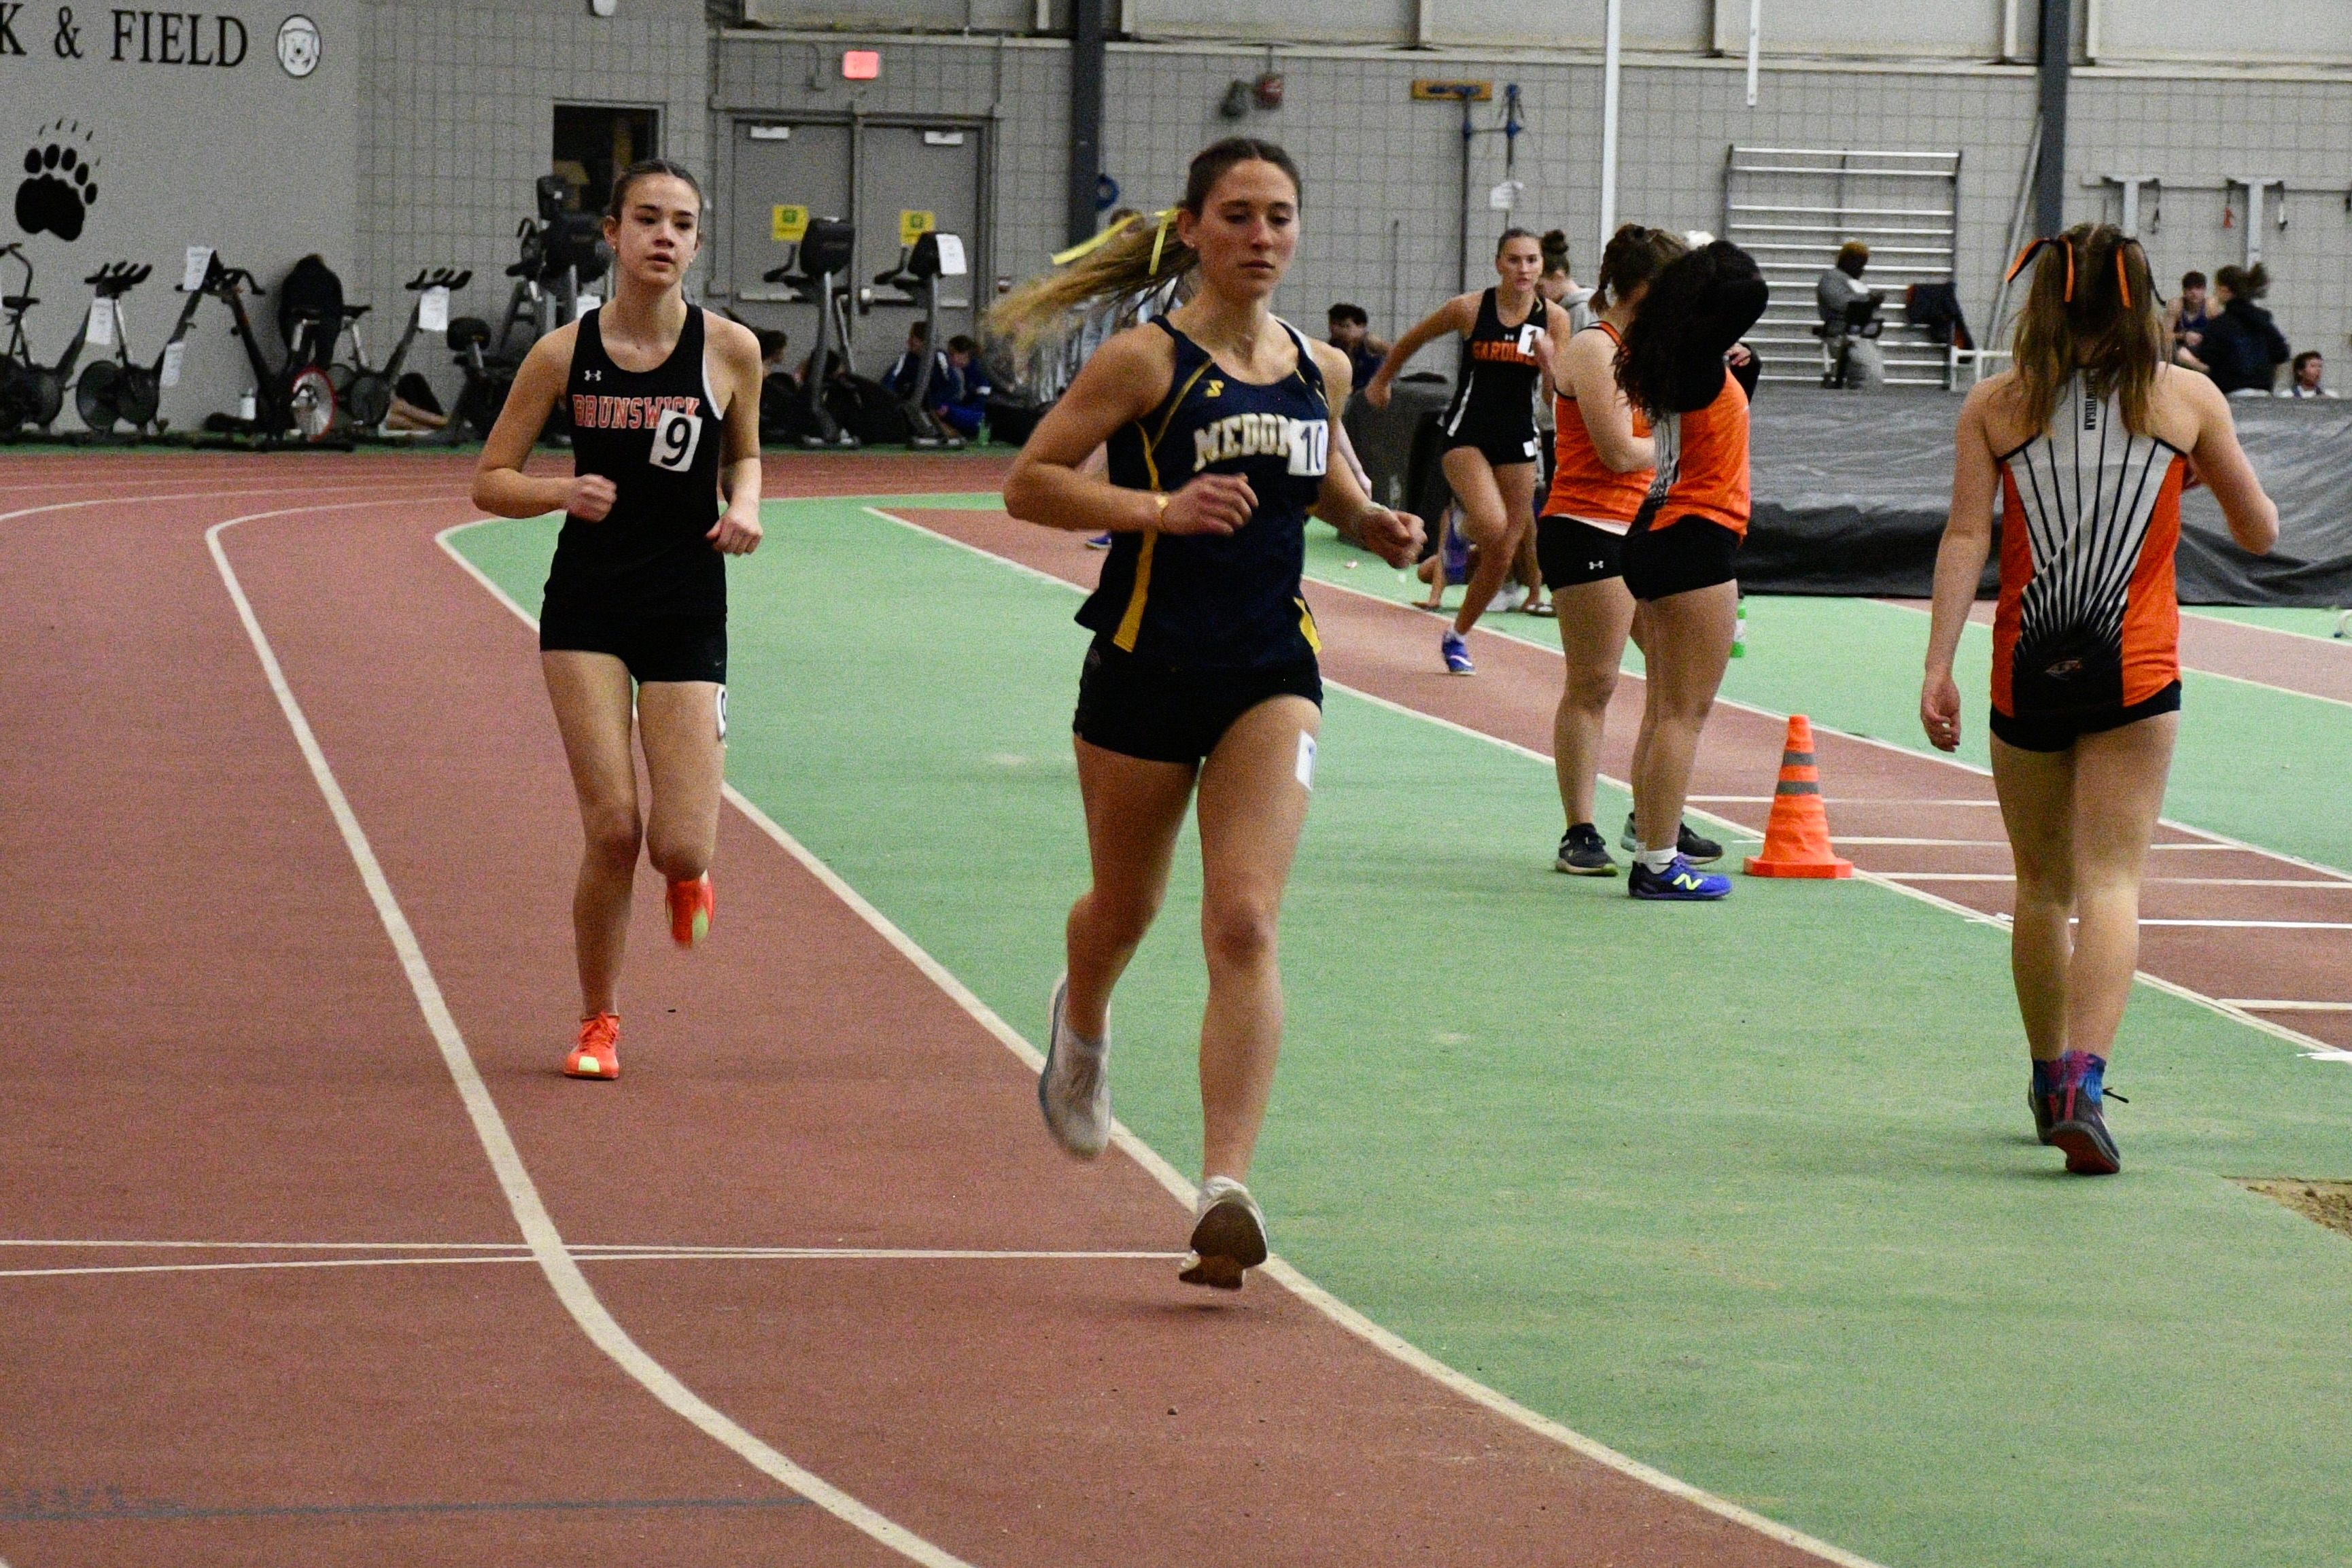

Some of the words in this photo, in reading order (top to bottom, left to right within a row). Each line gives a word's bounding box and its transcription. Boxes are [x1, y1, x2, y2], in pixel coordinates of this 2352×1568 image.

[0, 3, 27, 56] K
[54, 5, 83, 58] &
[110, 10, 249, 67] FIELD
[660, 417, 692, 467] 9
